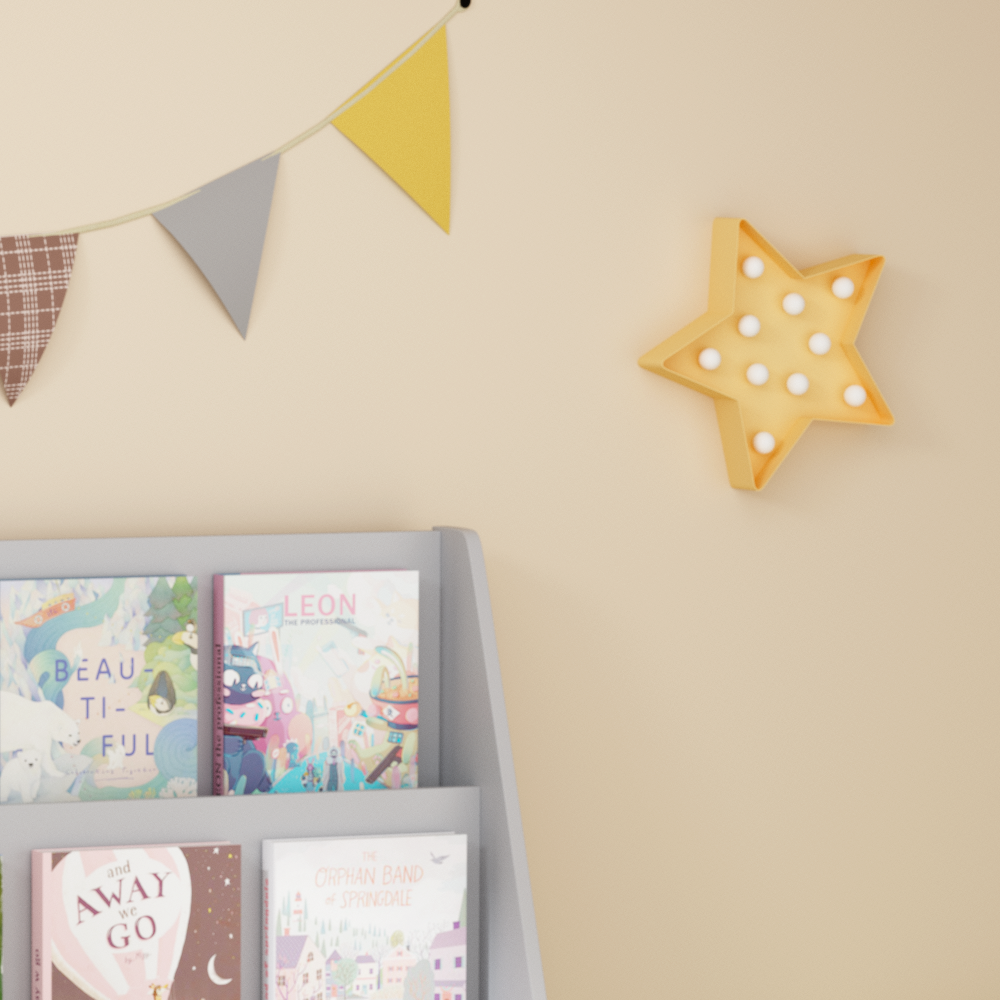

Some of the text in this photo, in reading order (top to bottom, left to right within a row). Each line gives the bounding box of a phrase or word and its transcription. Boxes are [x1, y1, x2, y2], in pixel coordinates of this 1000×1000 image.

[284, 594, 356, 617] LEON
[55, 657, 154, 682] BEAU-
[80, 696, 126, 719] TI-
[102, 733, 154, 758] FUL
[362, 850, 378, 862] THE
[107, 860, 132, 878] and
[314, 864, 424, 888] ORPHAN BAND
[76, 872, 172, 926] AWAY
[325, 889, 413, 910] of SPRINGDALE
[118, 905, 138, 920] we
[106, 914, 157, 950] GO
